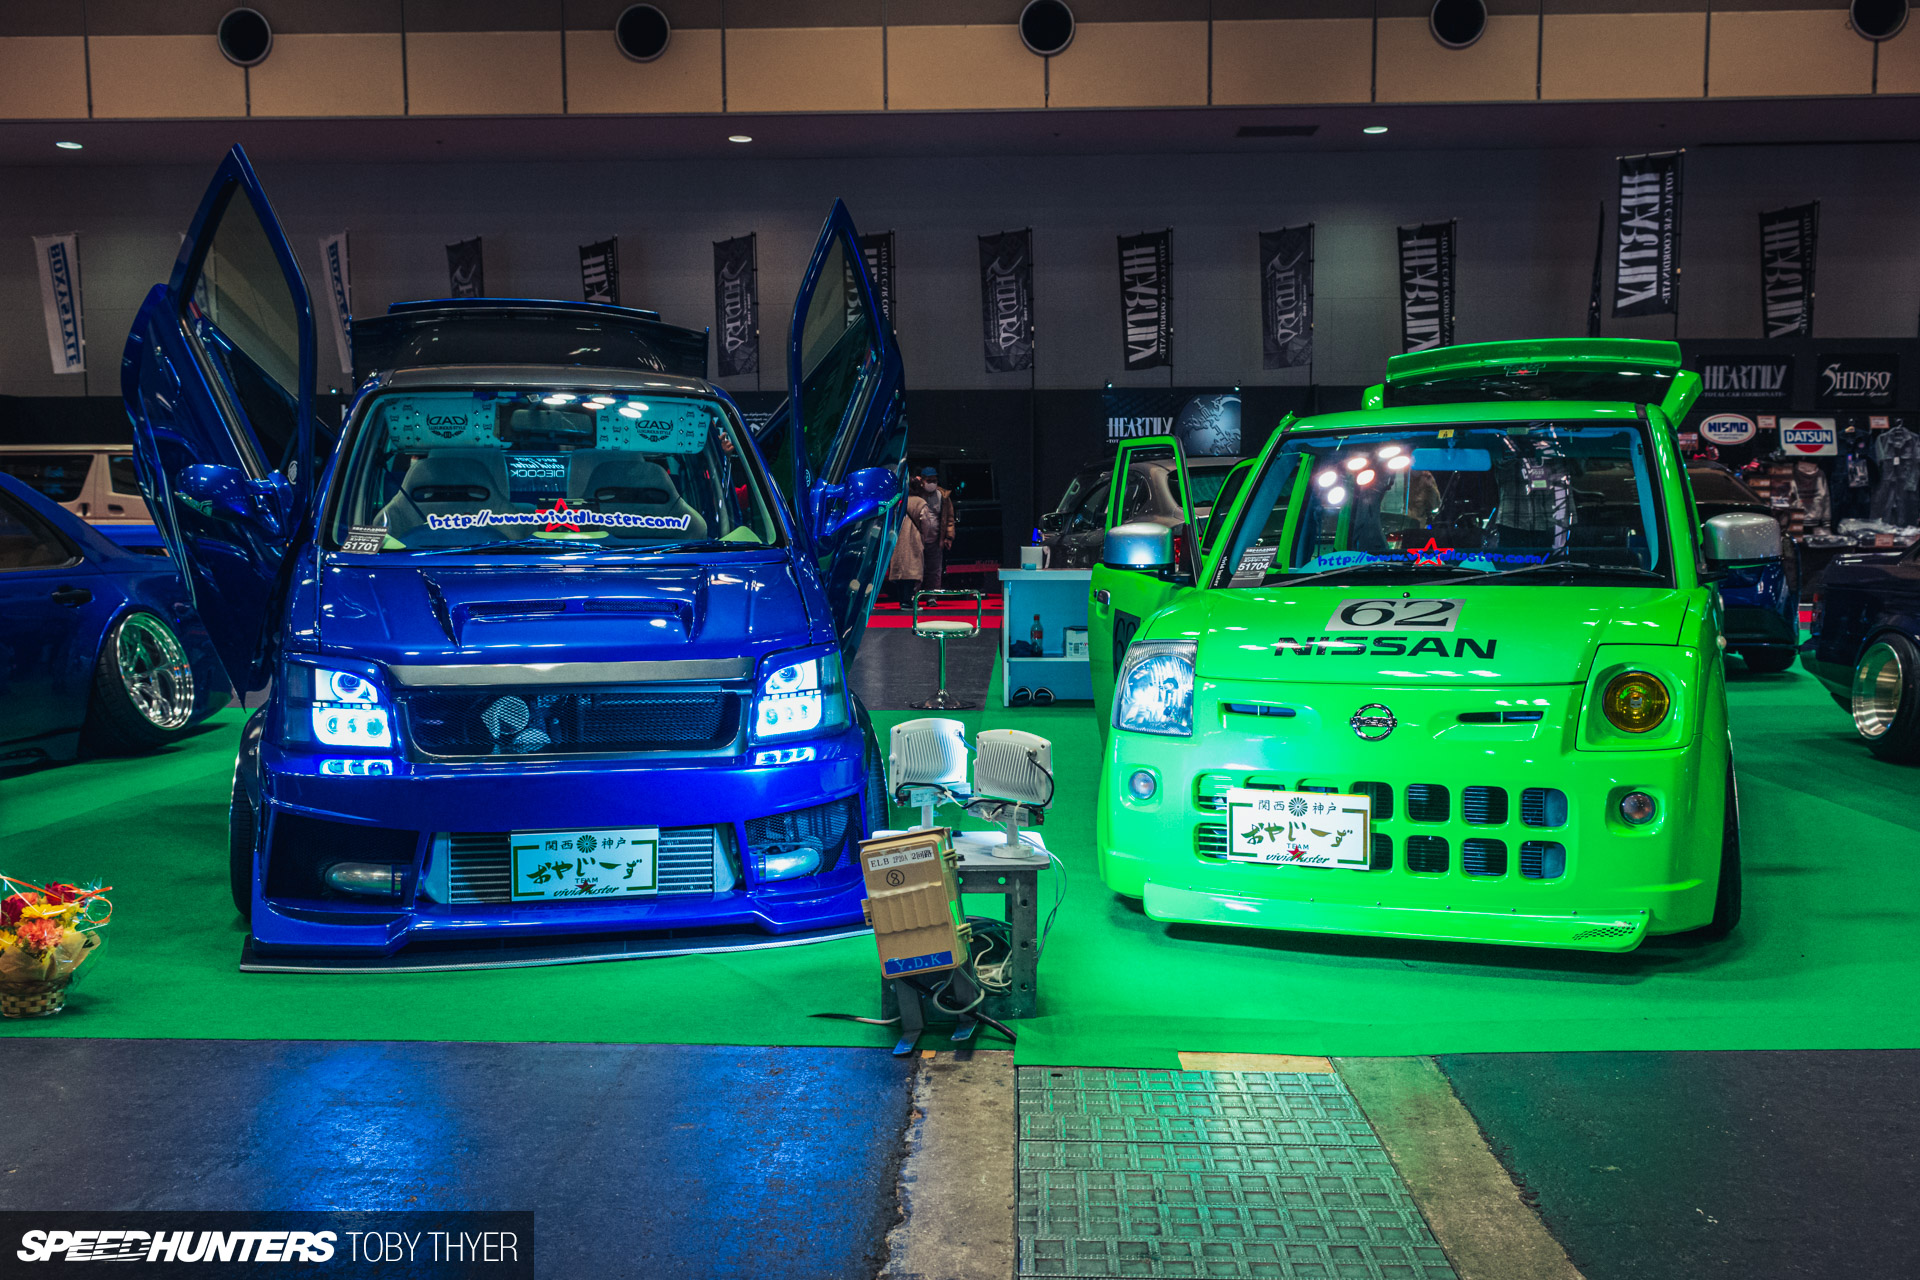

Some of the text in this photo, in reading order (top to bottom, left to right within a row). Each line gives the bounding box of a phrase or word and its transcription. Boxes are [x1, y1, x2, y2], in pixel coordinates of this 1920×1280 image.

[1703, 365, 1787, 390] HEARTILY
[1822, 363, 1892, 396] SHINKO
[1106, 416, 1173, 437] HEARTILY
[1707, 422, 1749, 433] NISMO
[1786, 430, 1832, 444] DATSUN
[427, 509, 691, 530] http://www.vividluster.com/
[342, 541, 379, 552] 51701
[1237, 561, 1270, 571] 51704
[1317, 550, 1550, 566] http://www.vividluster.com/
[1340, 600, 1456, 628] 62
[1274, 636, 1498, 660] NISSAN
[1258, 799, 1337, 815] 関西 神戸
[545, 837, 627, 851] 関西 神戸
[1286, 842, 1310, 850] TEAM
[870, 857, 890, 868] ELB
